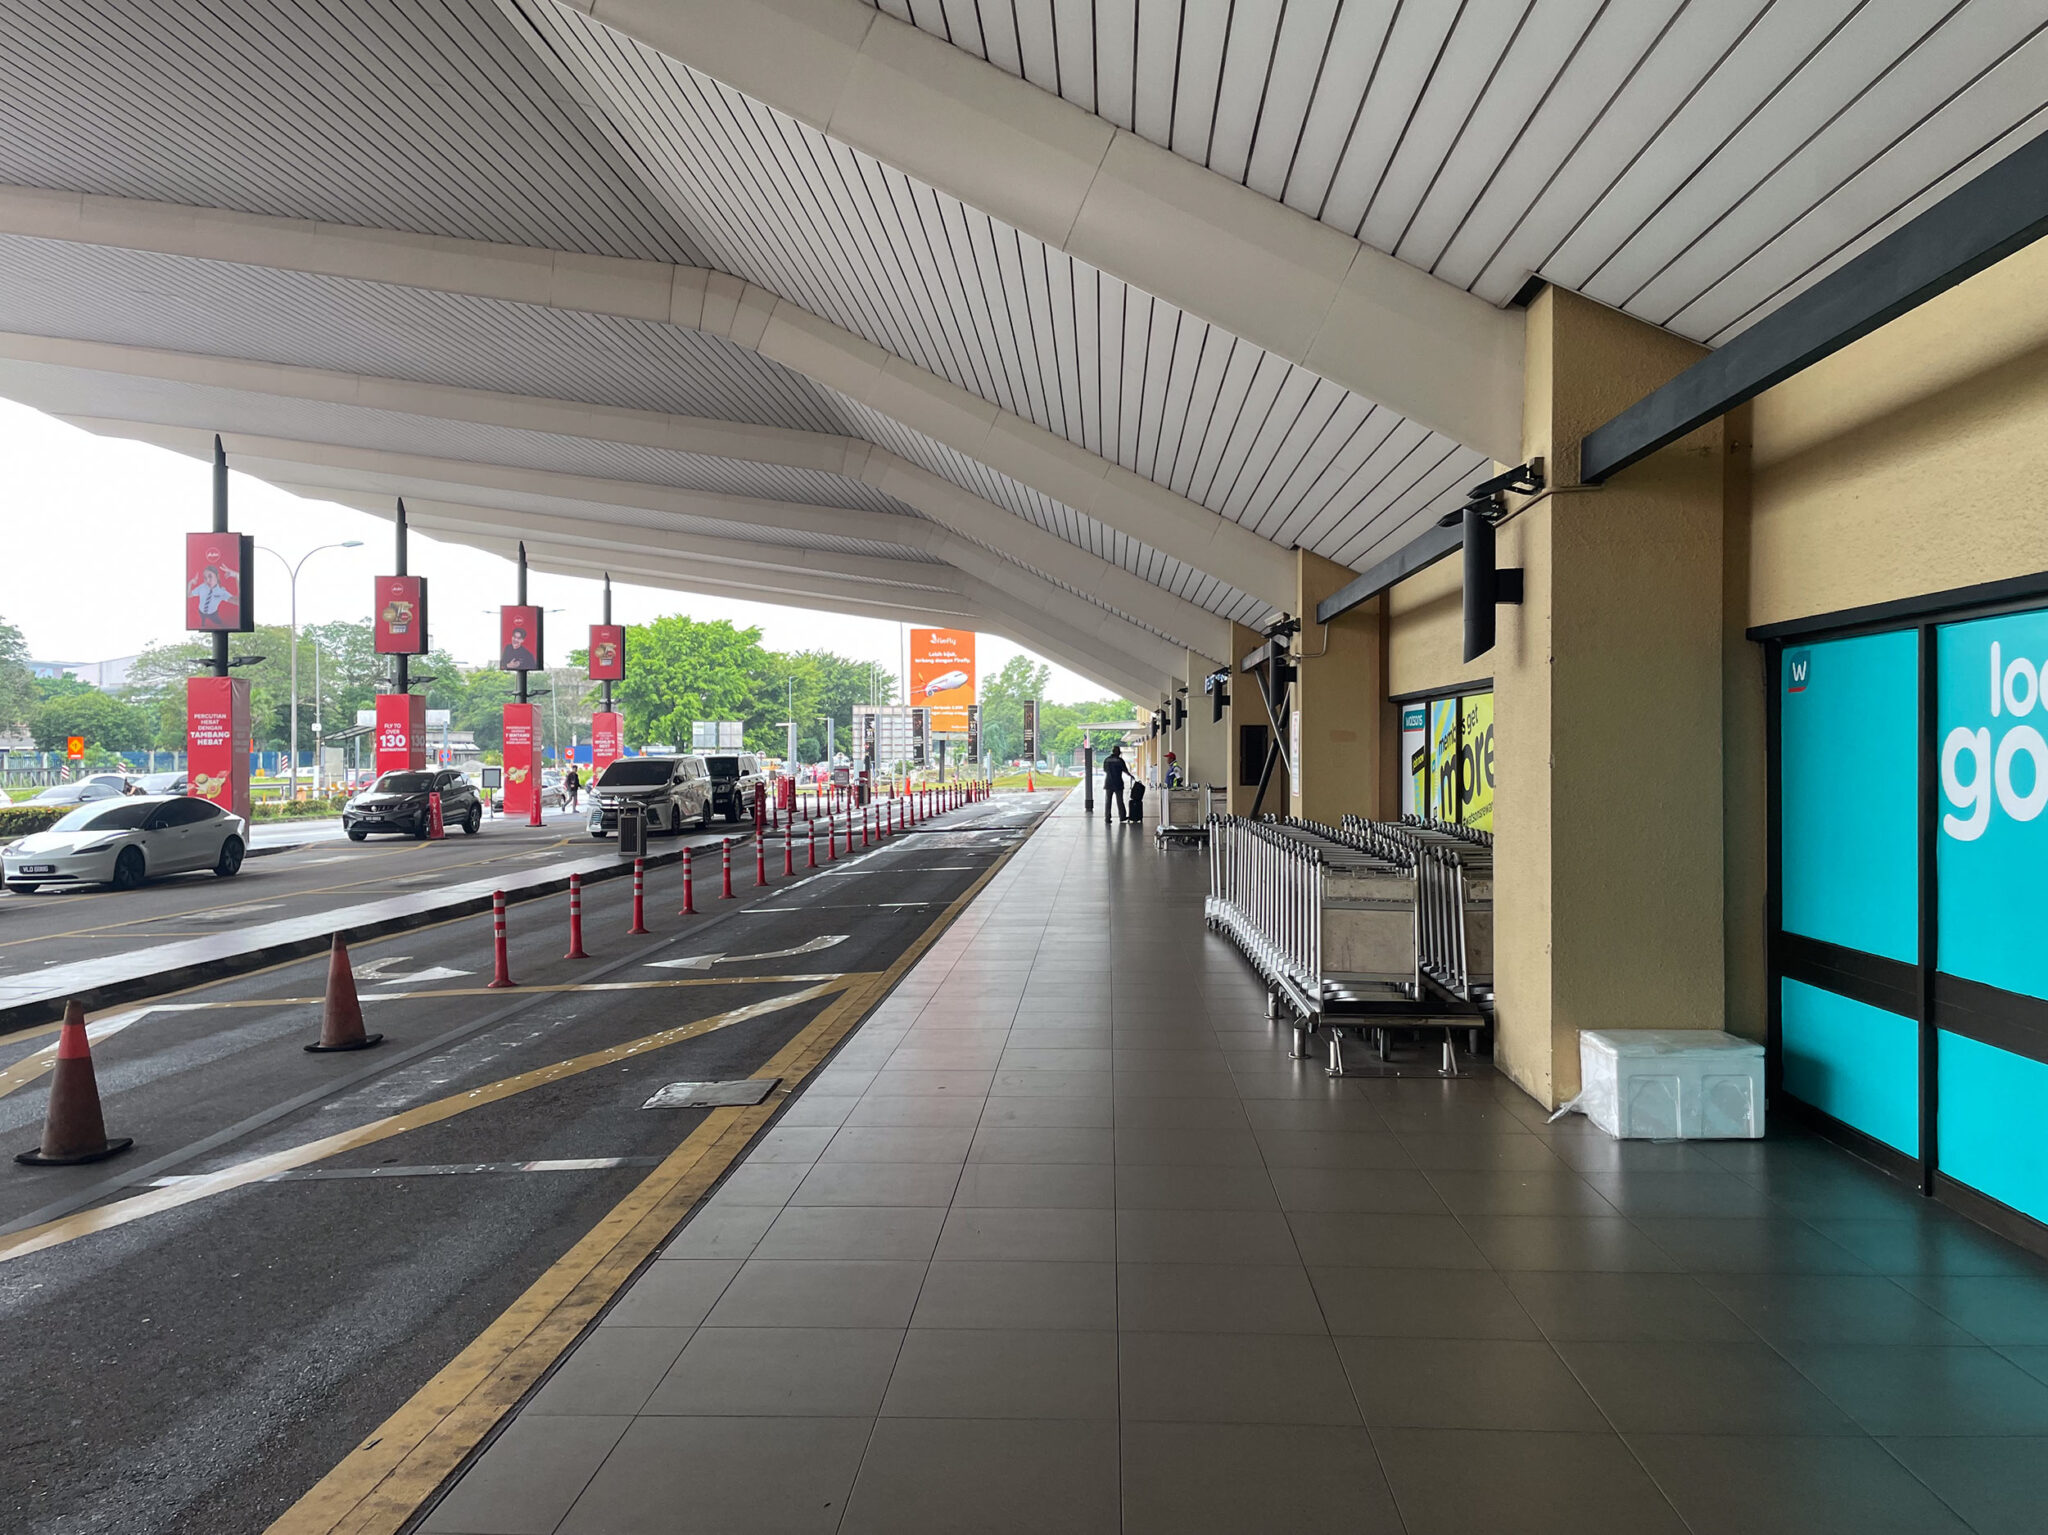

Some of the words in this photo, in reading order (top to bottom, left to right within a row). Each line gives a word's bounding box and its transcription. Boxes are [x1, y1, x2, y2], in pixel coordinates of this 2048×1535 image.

[1990, 640, 2048, 718] lo
[1467, 703, 1478, 735] get
[197, 738, 224, 746] HEBAT
[380, 734, 406, 747] 130
[1941, 724, 2048, 842] go
